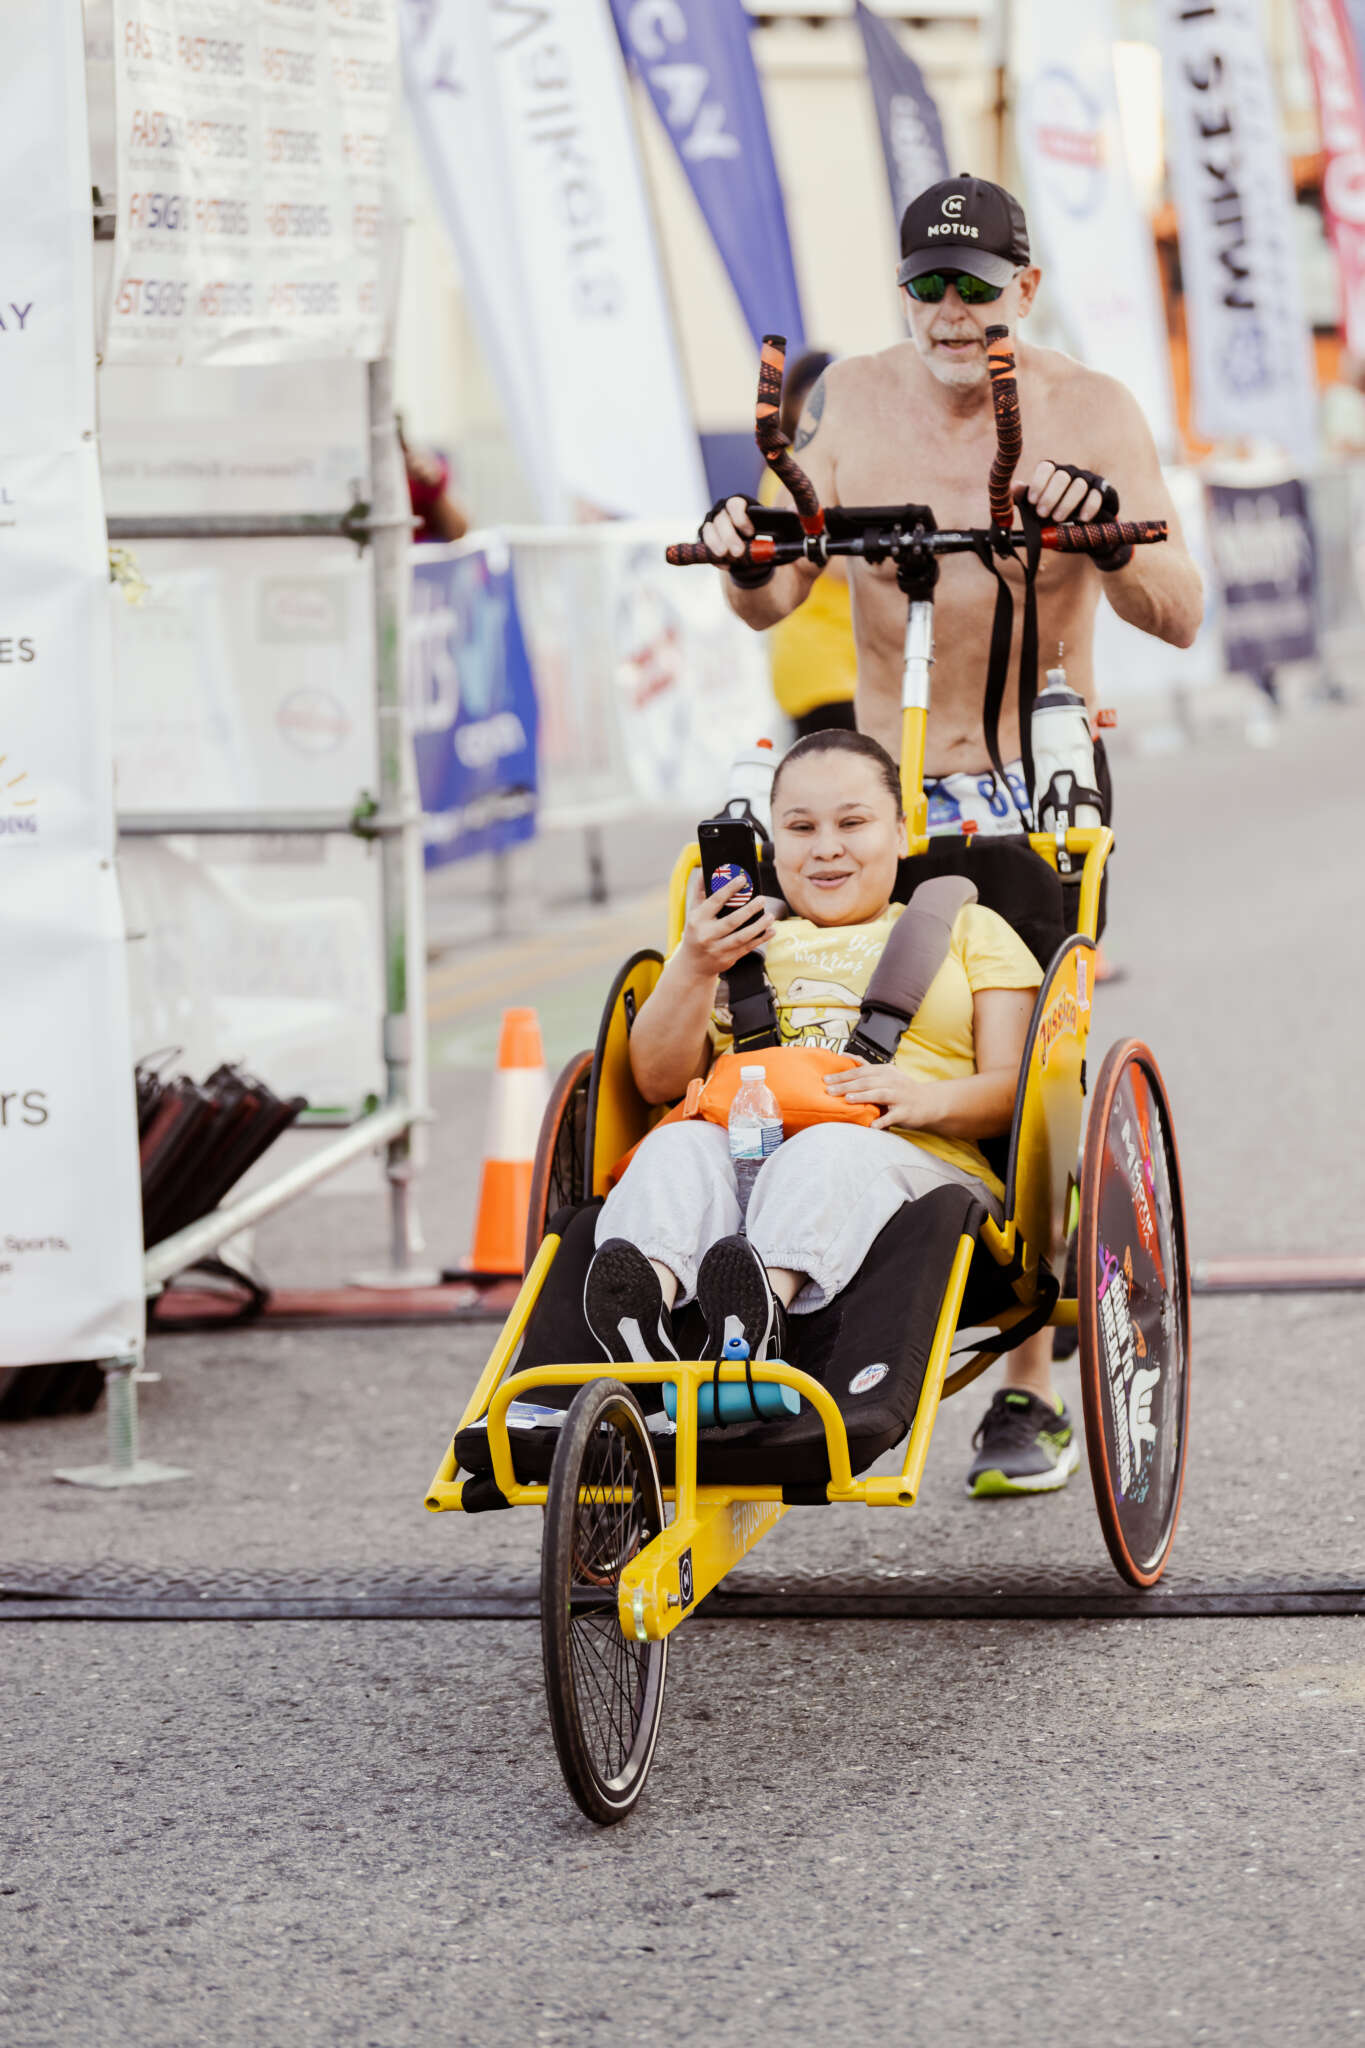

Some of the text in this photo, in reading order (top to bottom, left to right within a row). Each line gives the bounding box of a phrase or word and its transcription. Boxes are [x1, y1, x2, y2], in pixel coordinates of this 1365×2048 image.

[927, 223, 979, 238] MOTUS
[1040, 991, 1078, 1065] Jessica
[1110, 1272, 1129, 1348] BORN
[1122, 1341, 1134, 1382] TO
[1101, 1288, 1122, 1380] BREAK
[1113, 1371, 1131, 1496] BARRIERS
